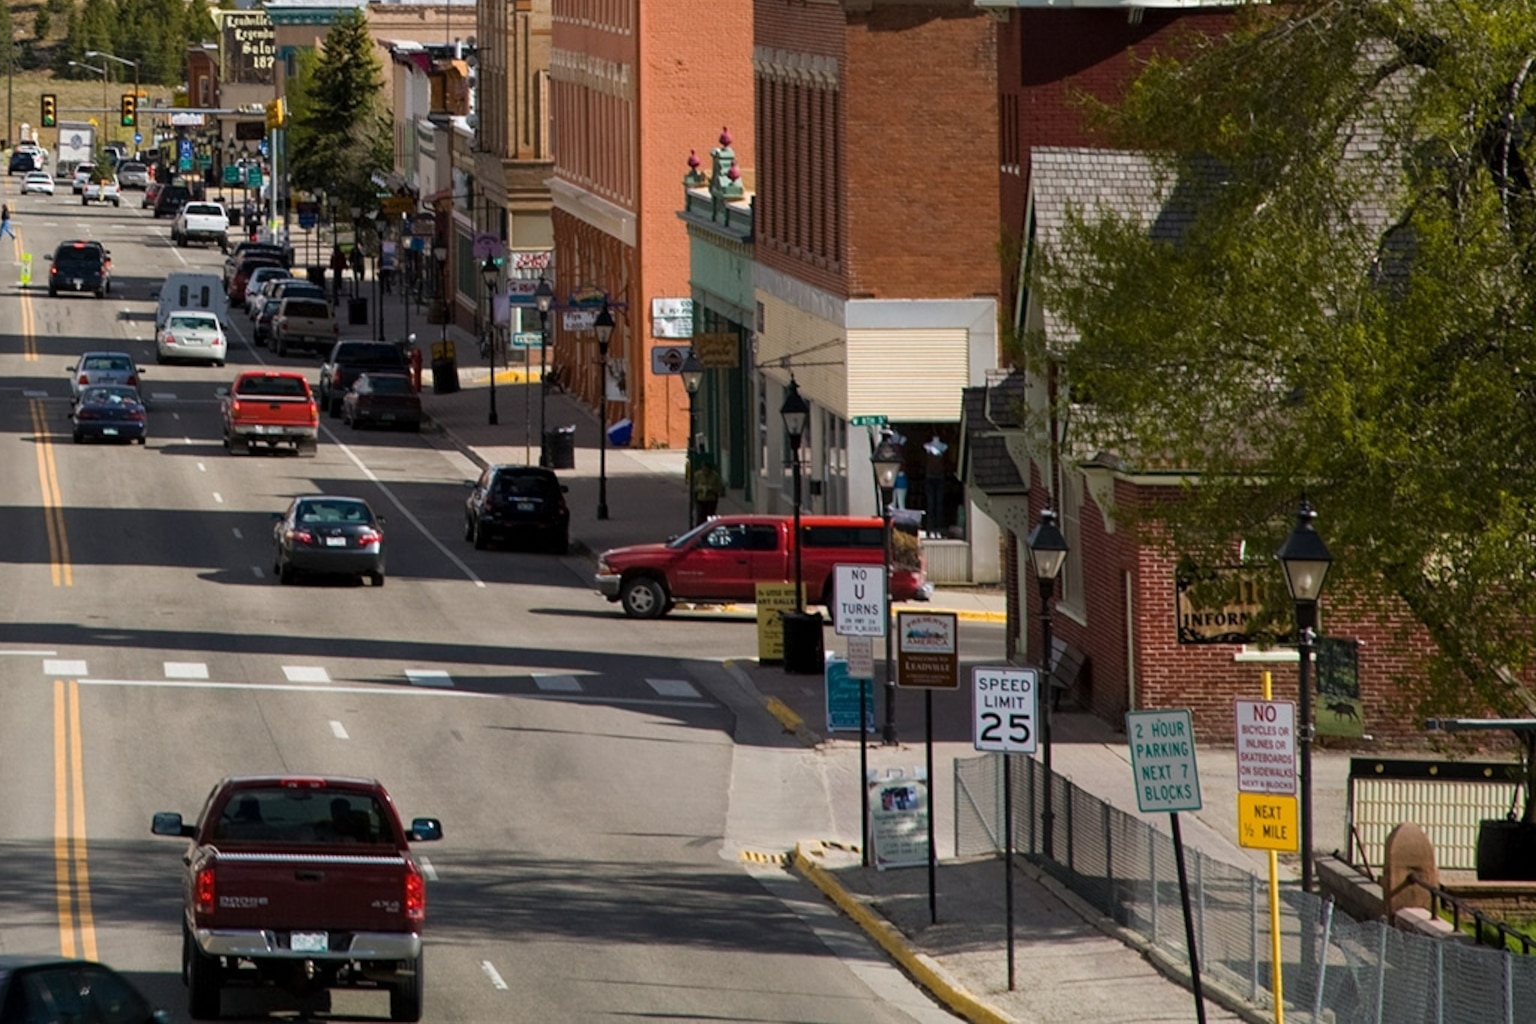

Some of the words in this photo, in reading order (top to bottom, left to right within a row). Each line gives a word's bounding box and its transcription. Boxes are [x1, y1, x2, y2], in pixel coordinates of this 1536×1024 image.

[234, 29, 274, 41] Legenda
[242, 41, 275, 54] Salo
[253, 56, 274, 68] 187
[851, 569, 867, 581] NO
[854, 584, 865, 600] U
[842, 602, 879, 616] TURNS
[906, 616, 950, 630] PRESERVE
[907, 637, 949, 647] AMERICA
[905, 661, 950, 672] LEADVILLE
[979, 677, 1031, 693] SPEED
[984, 695, 1025, 709] LIMIT
[1253, 704, 1277, 723] NO
[980, 712, 1030, 743] 25
[1135, 723, 1143, 738] 2
[1151, 721, 1185, 738] HOUR
[1241, 725, 1276, 736] BICYCLES
[1278, 726, 1289, 736] OR
[1136, 742, 1189, 759] PARKING
[1245, 739, 1274, 750] INLINES
[1275, 740, 1286, 750] OR
[1240, 753, 1292, 765] SKATEBOARDS
[1142, 764, 1172, 781] NEXT
[1181, 763, 1188, 779] 7
[1240, 766, 1252, 776] ON
[1252, 766, 1293, 778] SIDEWALKS
[1242, 779, 1260, 788] NEXT
[1267, 780, 1293, 790] BLOCKS
[1144, 784, 1192, 801] BLOCKS
[1254, 804, 1282, 820] NEXT
[1263, 824, 1288, 840] MILE
